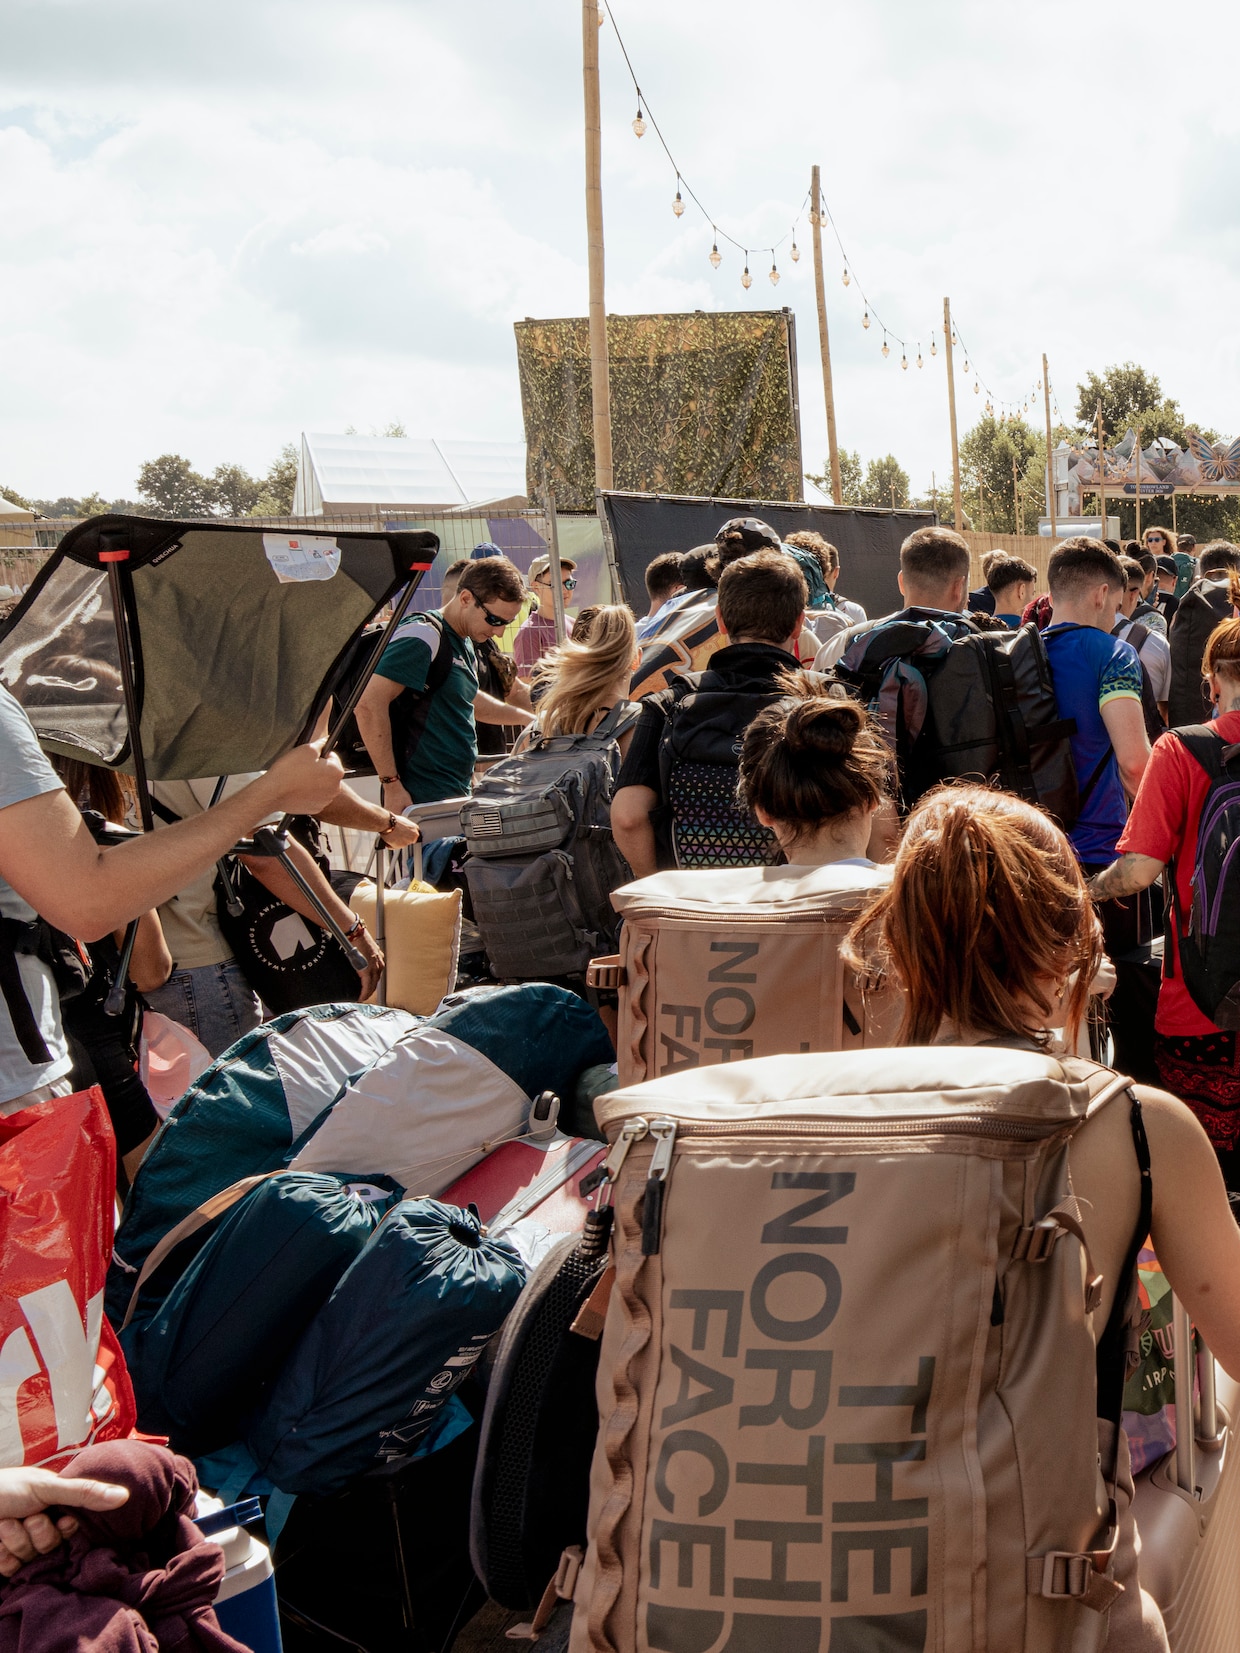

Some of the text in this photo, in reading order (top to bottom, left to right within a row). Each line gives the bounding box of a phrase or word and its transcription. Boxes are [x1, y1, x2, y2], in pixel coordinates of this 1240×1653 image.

[152, 544, 178, 563] QUECHUA
[660, 1003, 702, 1075] FA
[648, 1289, 745, 1597] FACE
[732, 1172, 857, 1602] NORTH
[830, 1356, 936, 1602] THE
